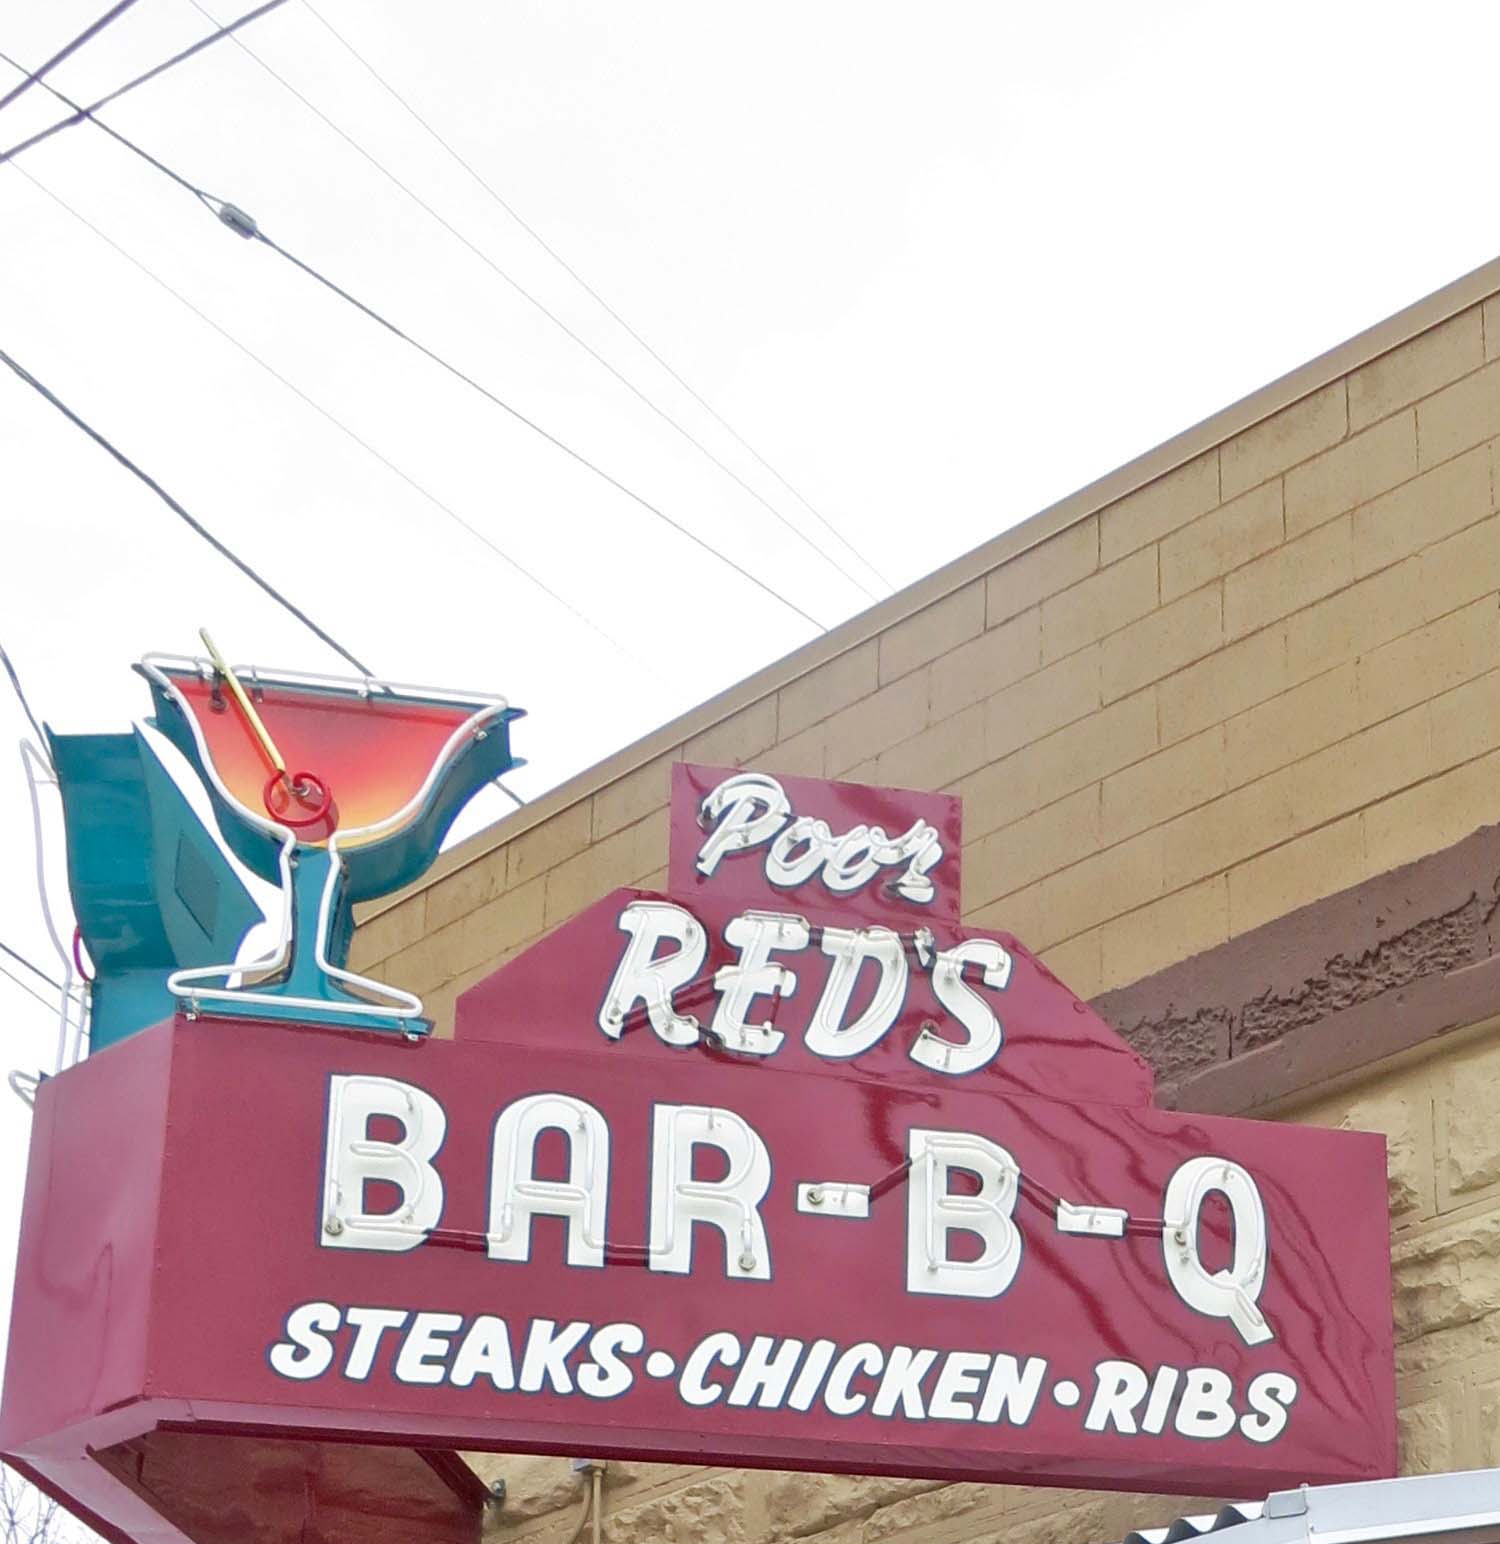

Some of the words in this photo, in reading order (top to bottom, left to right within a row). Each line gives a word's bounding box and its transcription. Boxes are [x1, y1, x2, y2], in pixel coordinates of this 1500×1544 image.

[696, 773, 943, 903] Poor
[598, 900, 1012, 1075] RED'S
[320, 1073, 1274, 1346] BAR-B-Q
[269, 1301, 644, 1398] STEAKS
[679, 1332, 1047, 1425] CHICKEN
[1085, 1360, 1297, 1442] RIBS
